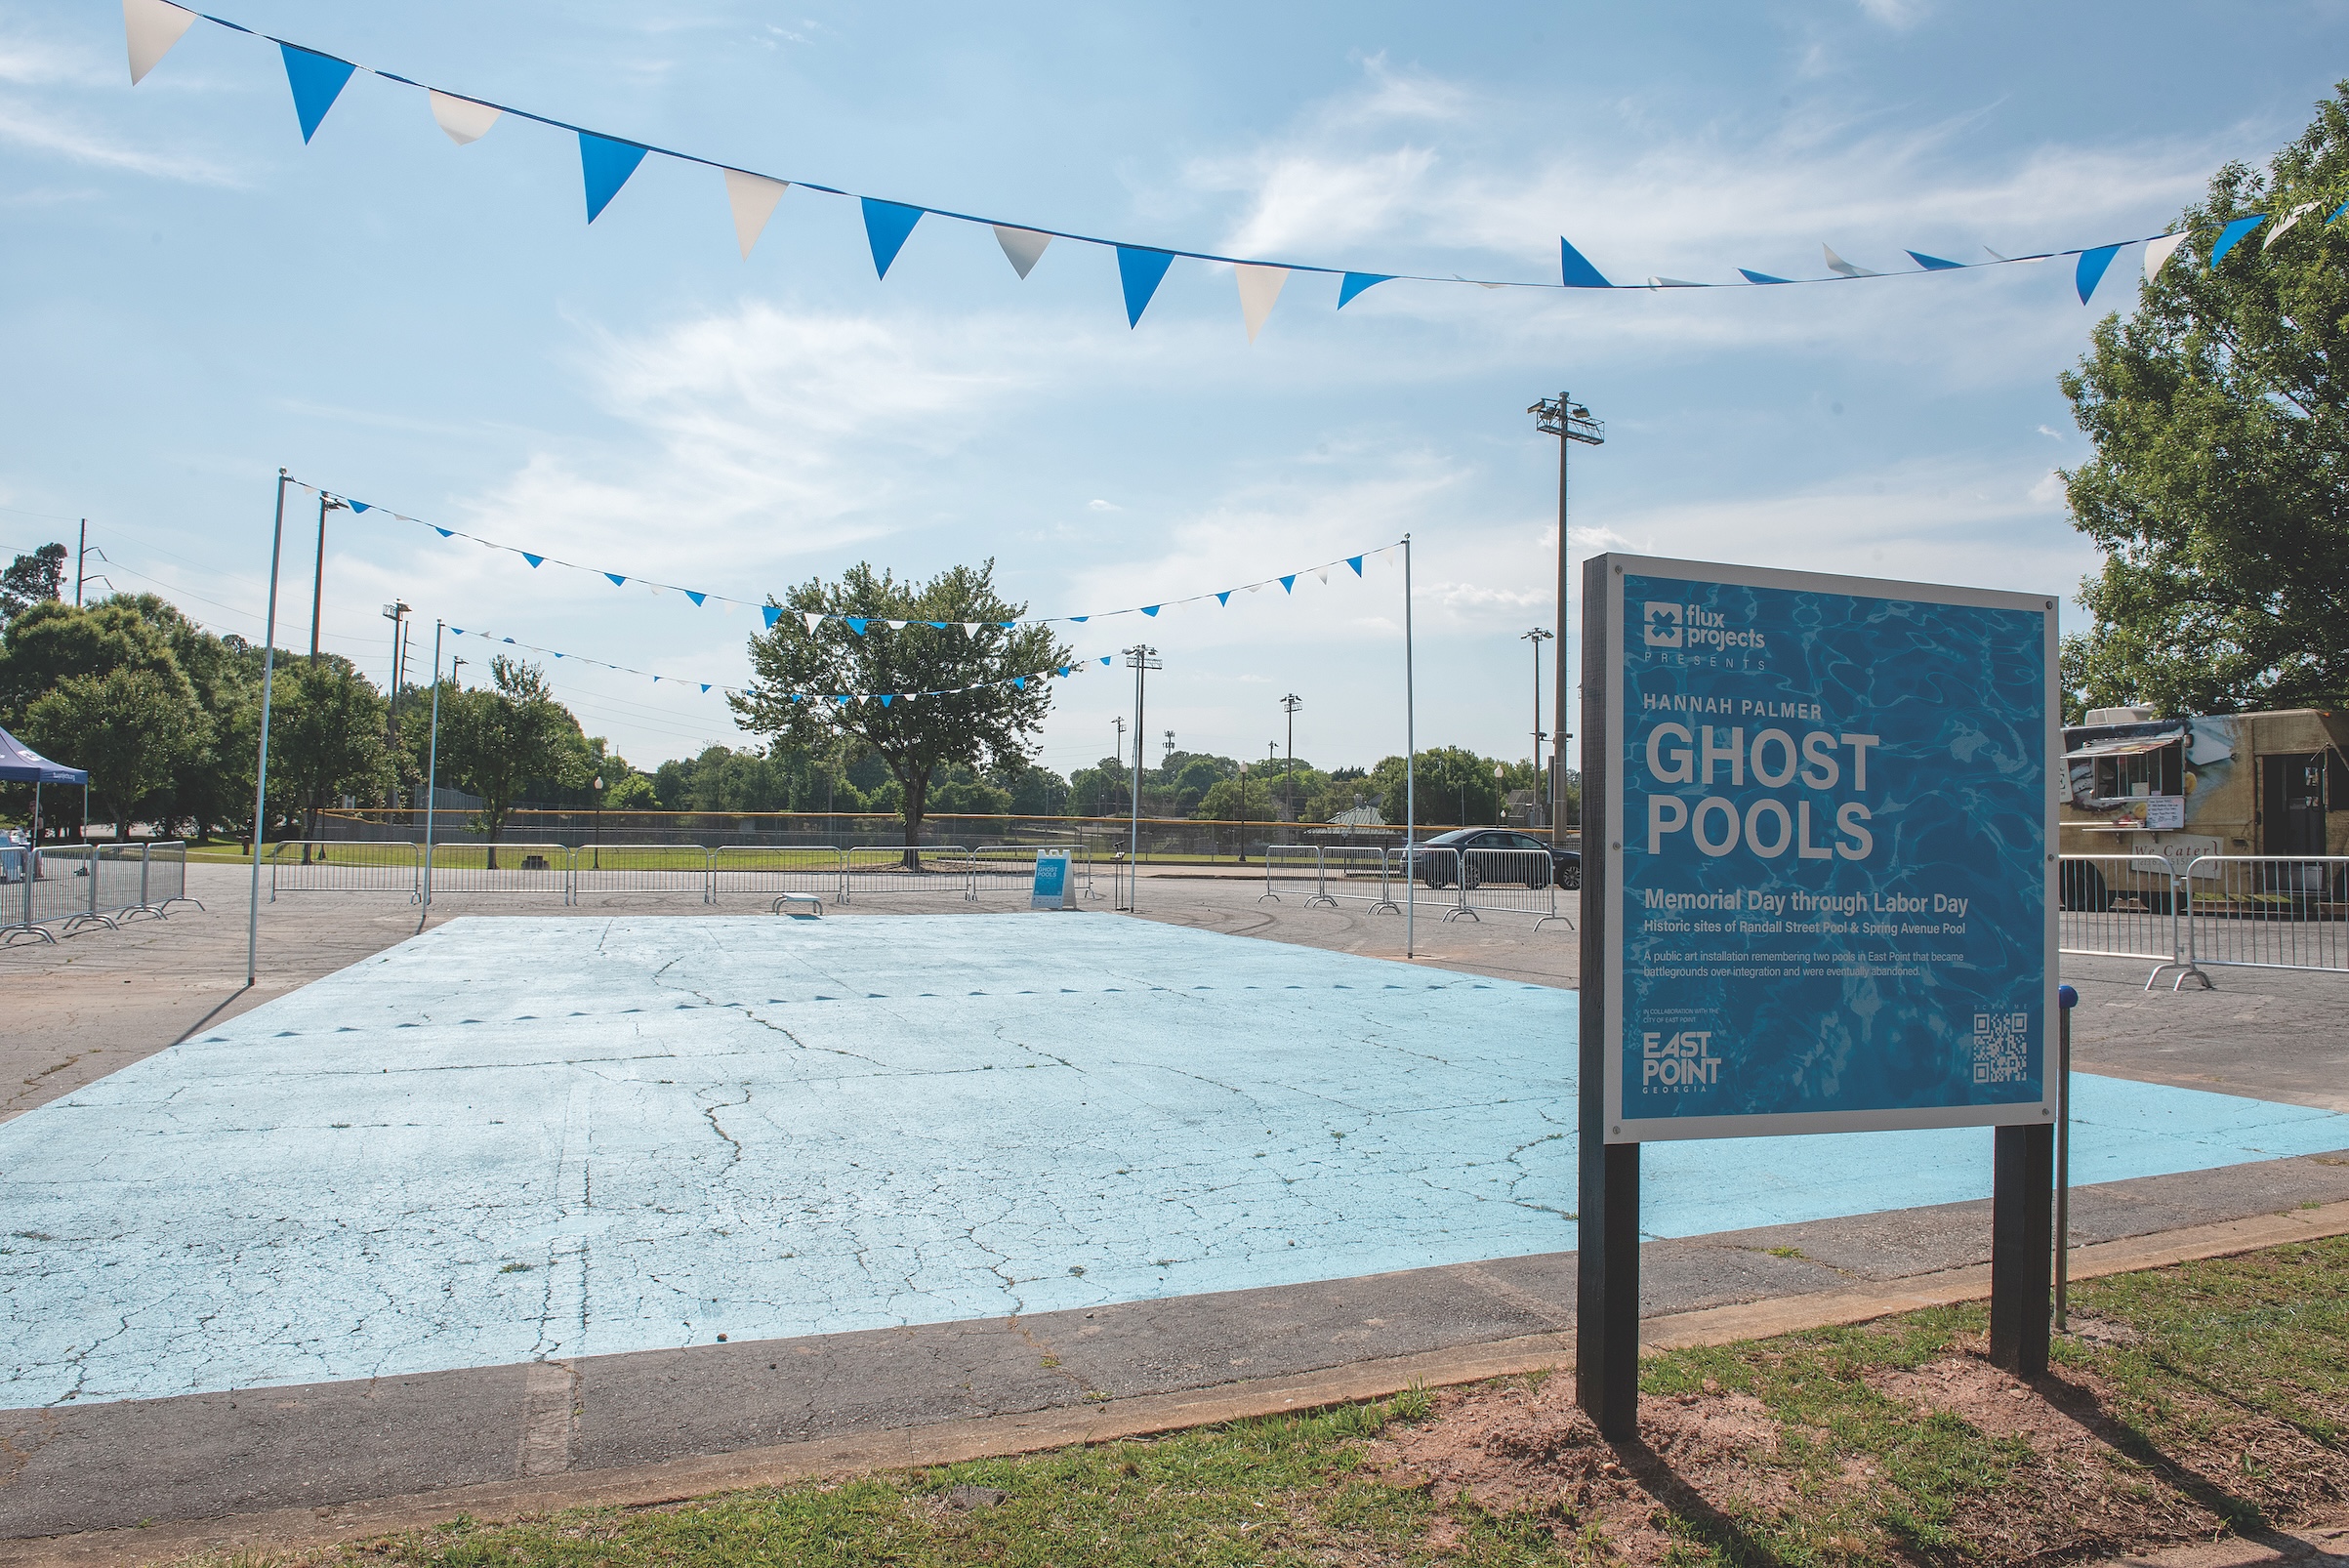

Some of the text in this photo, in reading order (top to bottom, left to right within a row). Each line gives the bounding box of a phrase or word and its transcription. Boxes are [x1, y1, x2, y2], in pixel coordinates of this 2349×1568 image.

[1686, 604, 1725, 629] flux
[1687, 628, 1765, 652] projects
[1644, 651, 1765, 671] PRESENTS
[1643, 693, 1822, 721] HANNAH PALMER
[1646, 722, 1880, 792] GHOST
[1647, 794, 1875, 861] POOLS
[2135, 845, 2209, 857] We Cater
[1644, 887, 1968, 918] Memorial Day through Labor Day
[1644, 920, 1965, 936] Historic sites of Randall Street Pool & Spring Avenue Pool
[1643, 950, 1964, 964] A public art installation remembering two pools in East Point that became
[1643, 967, 1709, 978] battlegrounds
[1733, 967, 1781, 978] integration
[1783, 967, 1800, 976] and
[1826, 967, 1869, 978] eventually
[1871, 967, 1920, 976] abandoned.
[1643, 1031, 1711, 1058] EAST
[1643, 1057, 1722, 1086] POINT
